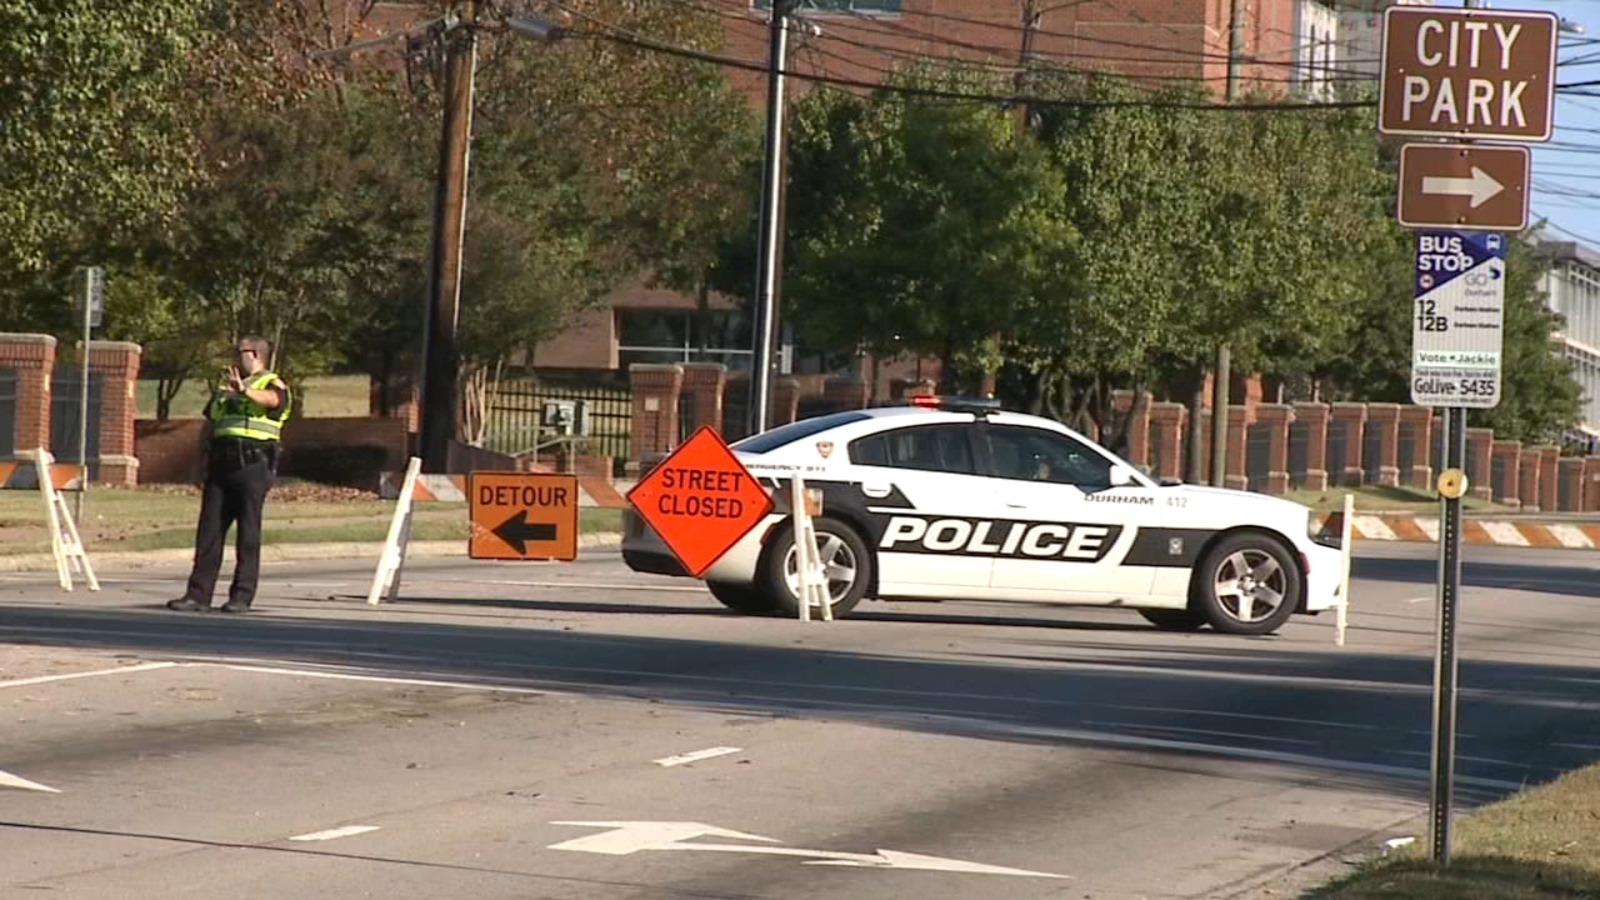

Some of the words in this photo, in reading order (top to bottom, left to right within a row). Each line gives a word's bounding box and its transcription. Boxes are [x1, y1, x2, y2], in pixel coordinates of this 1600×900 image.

[1417, 19, 1522, 70] CITY
[1402, 75, 1528, 128] PARK
[1420, 236, 1462, 253] BUS
[1418, 254, 1474, 272] STOP
[1418, 300, 1436, 315] 12
[1418, 316, 1448, 332] 12B
[1420, 353, 1447, 363] Vote
[1458, 354, 1496, 365] Jackie
[1414, 377, 1454, 395] GoLive
[1460, 379, 1495, 396] 5435
[661, 467, 743, 492] STREET
[480, 486, 567, 507] DETOUR
[1084, 494, 1154, 505] DURHAM
[1166, 497, 1187, 508] 412
[658, 494, 743, 519] CLOSED
[880, 516, 1109, 560] POLICE
